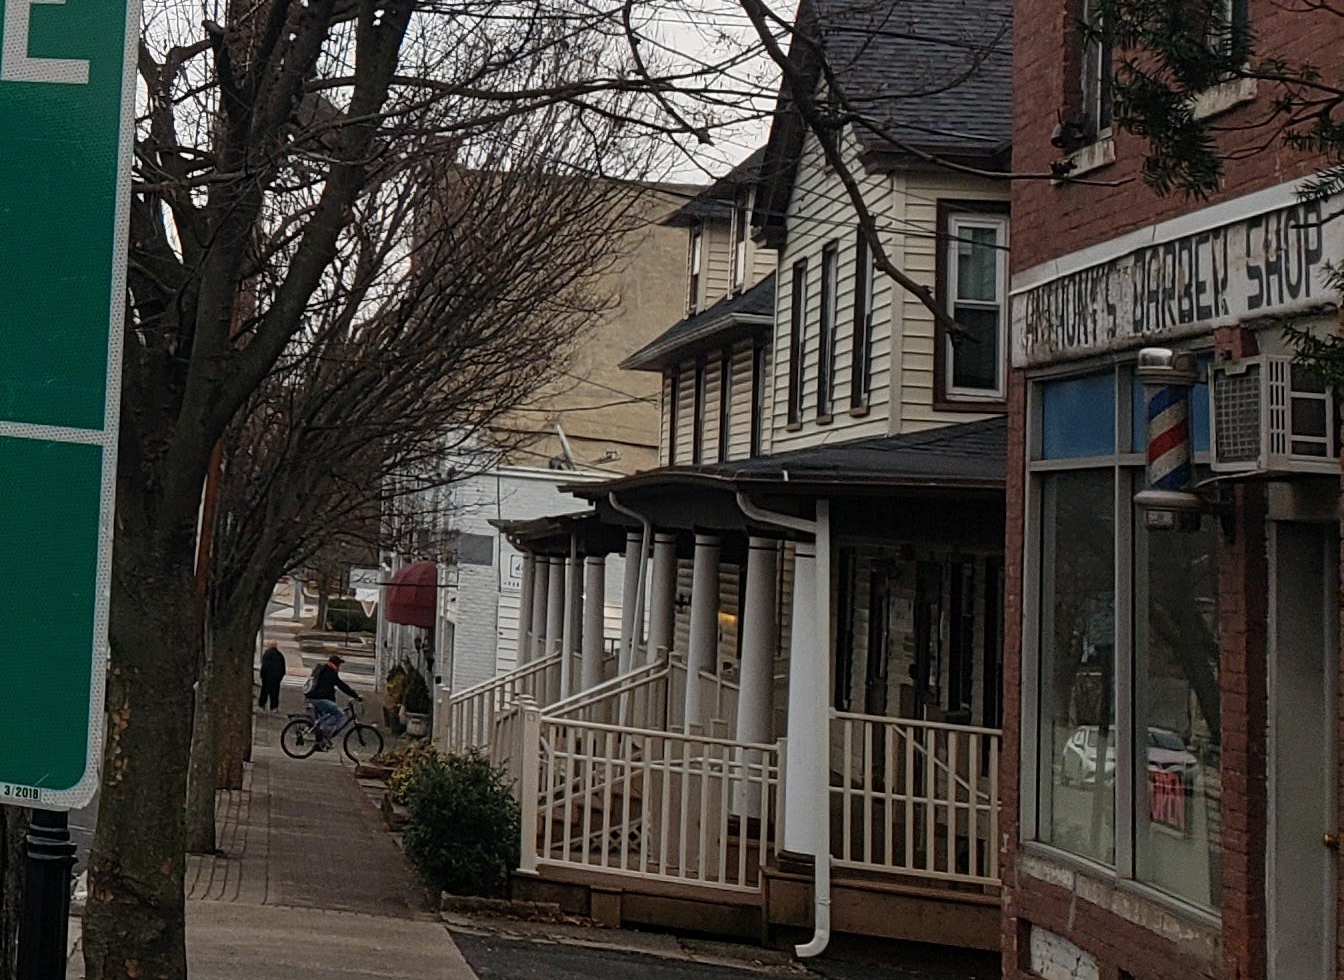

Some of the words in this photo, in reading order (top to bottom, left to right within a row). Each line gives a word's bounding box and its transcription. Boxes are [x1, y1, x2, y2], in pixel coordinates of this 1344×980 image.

[1131, 227, 1230, 335] BARBER
[1245, 201, 1323, 310] SHOP
[4, 785, 39, 799] 3/2018
